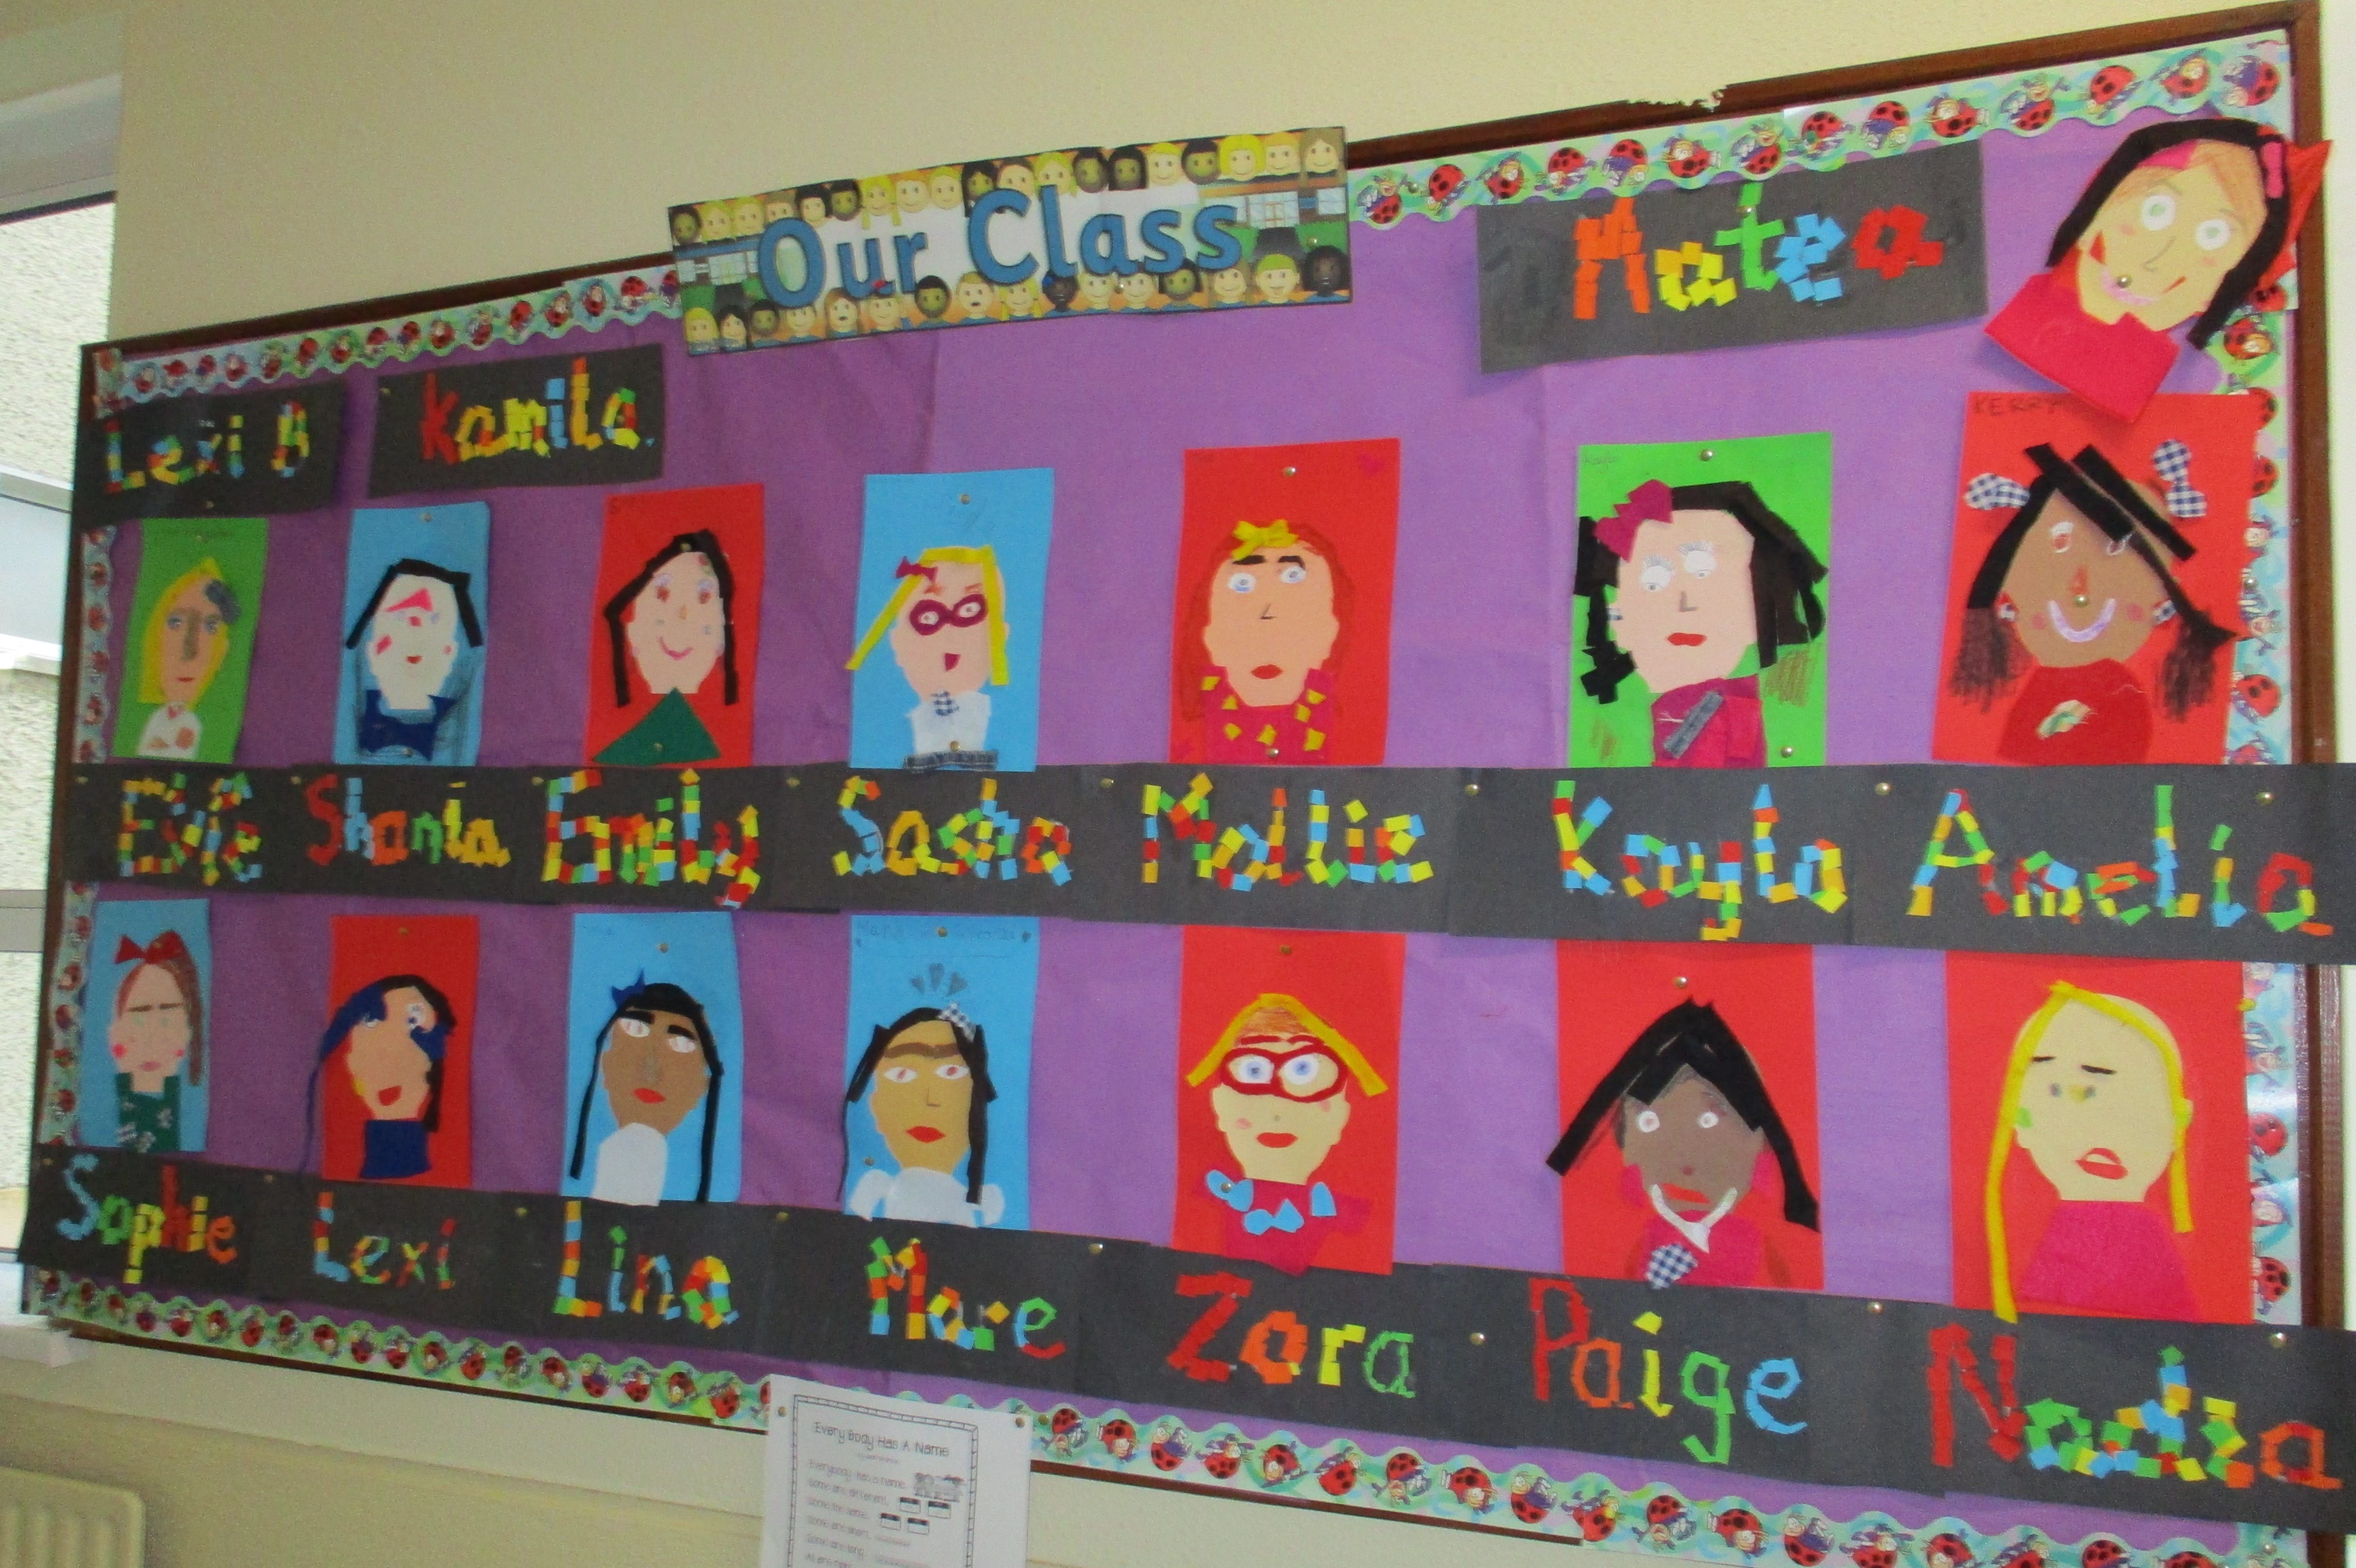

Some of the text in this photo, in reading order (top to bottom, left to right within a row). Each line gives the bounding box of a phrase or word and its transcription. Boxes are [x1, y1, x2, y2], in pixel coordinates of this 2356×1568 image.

[757, 184, 1242, 308] Our Class
[104, 415, 246, 493] Lexi
[305, 773, 511, 866] Shania
[542, 768, 760, 909] Emily
[832, 775, 1071, 886] Sasha
[1142, 773, 1434, 892] Mollie
[1552, 780, 1848, 941] Kayla
[1906, 785, 2334, 936] Amelia
[56, 1154, 238, 1285] Sophie
[313, 1192, 457, 1290] Lexi
[553, 1200, 739, 1329] Lina
[1529, 1277, 1808, 1464] Paige
[1927, 1323, 2343, 1489] Nadia
[814, 1422, 949, 1457] Every Body Has A Name
